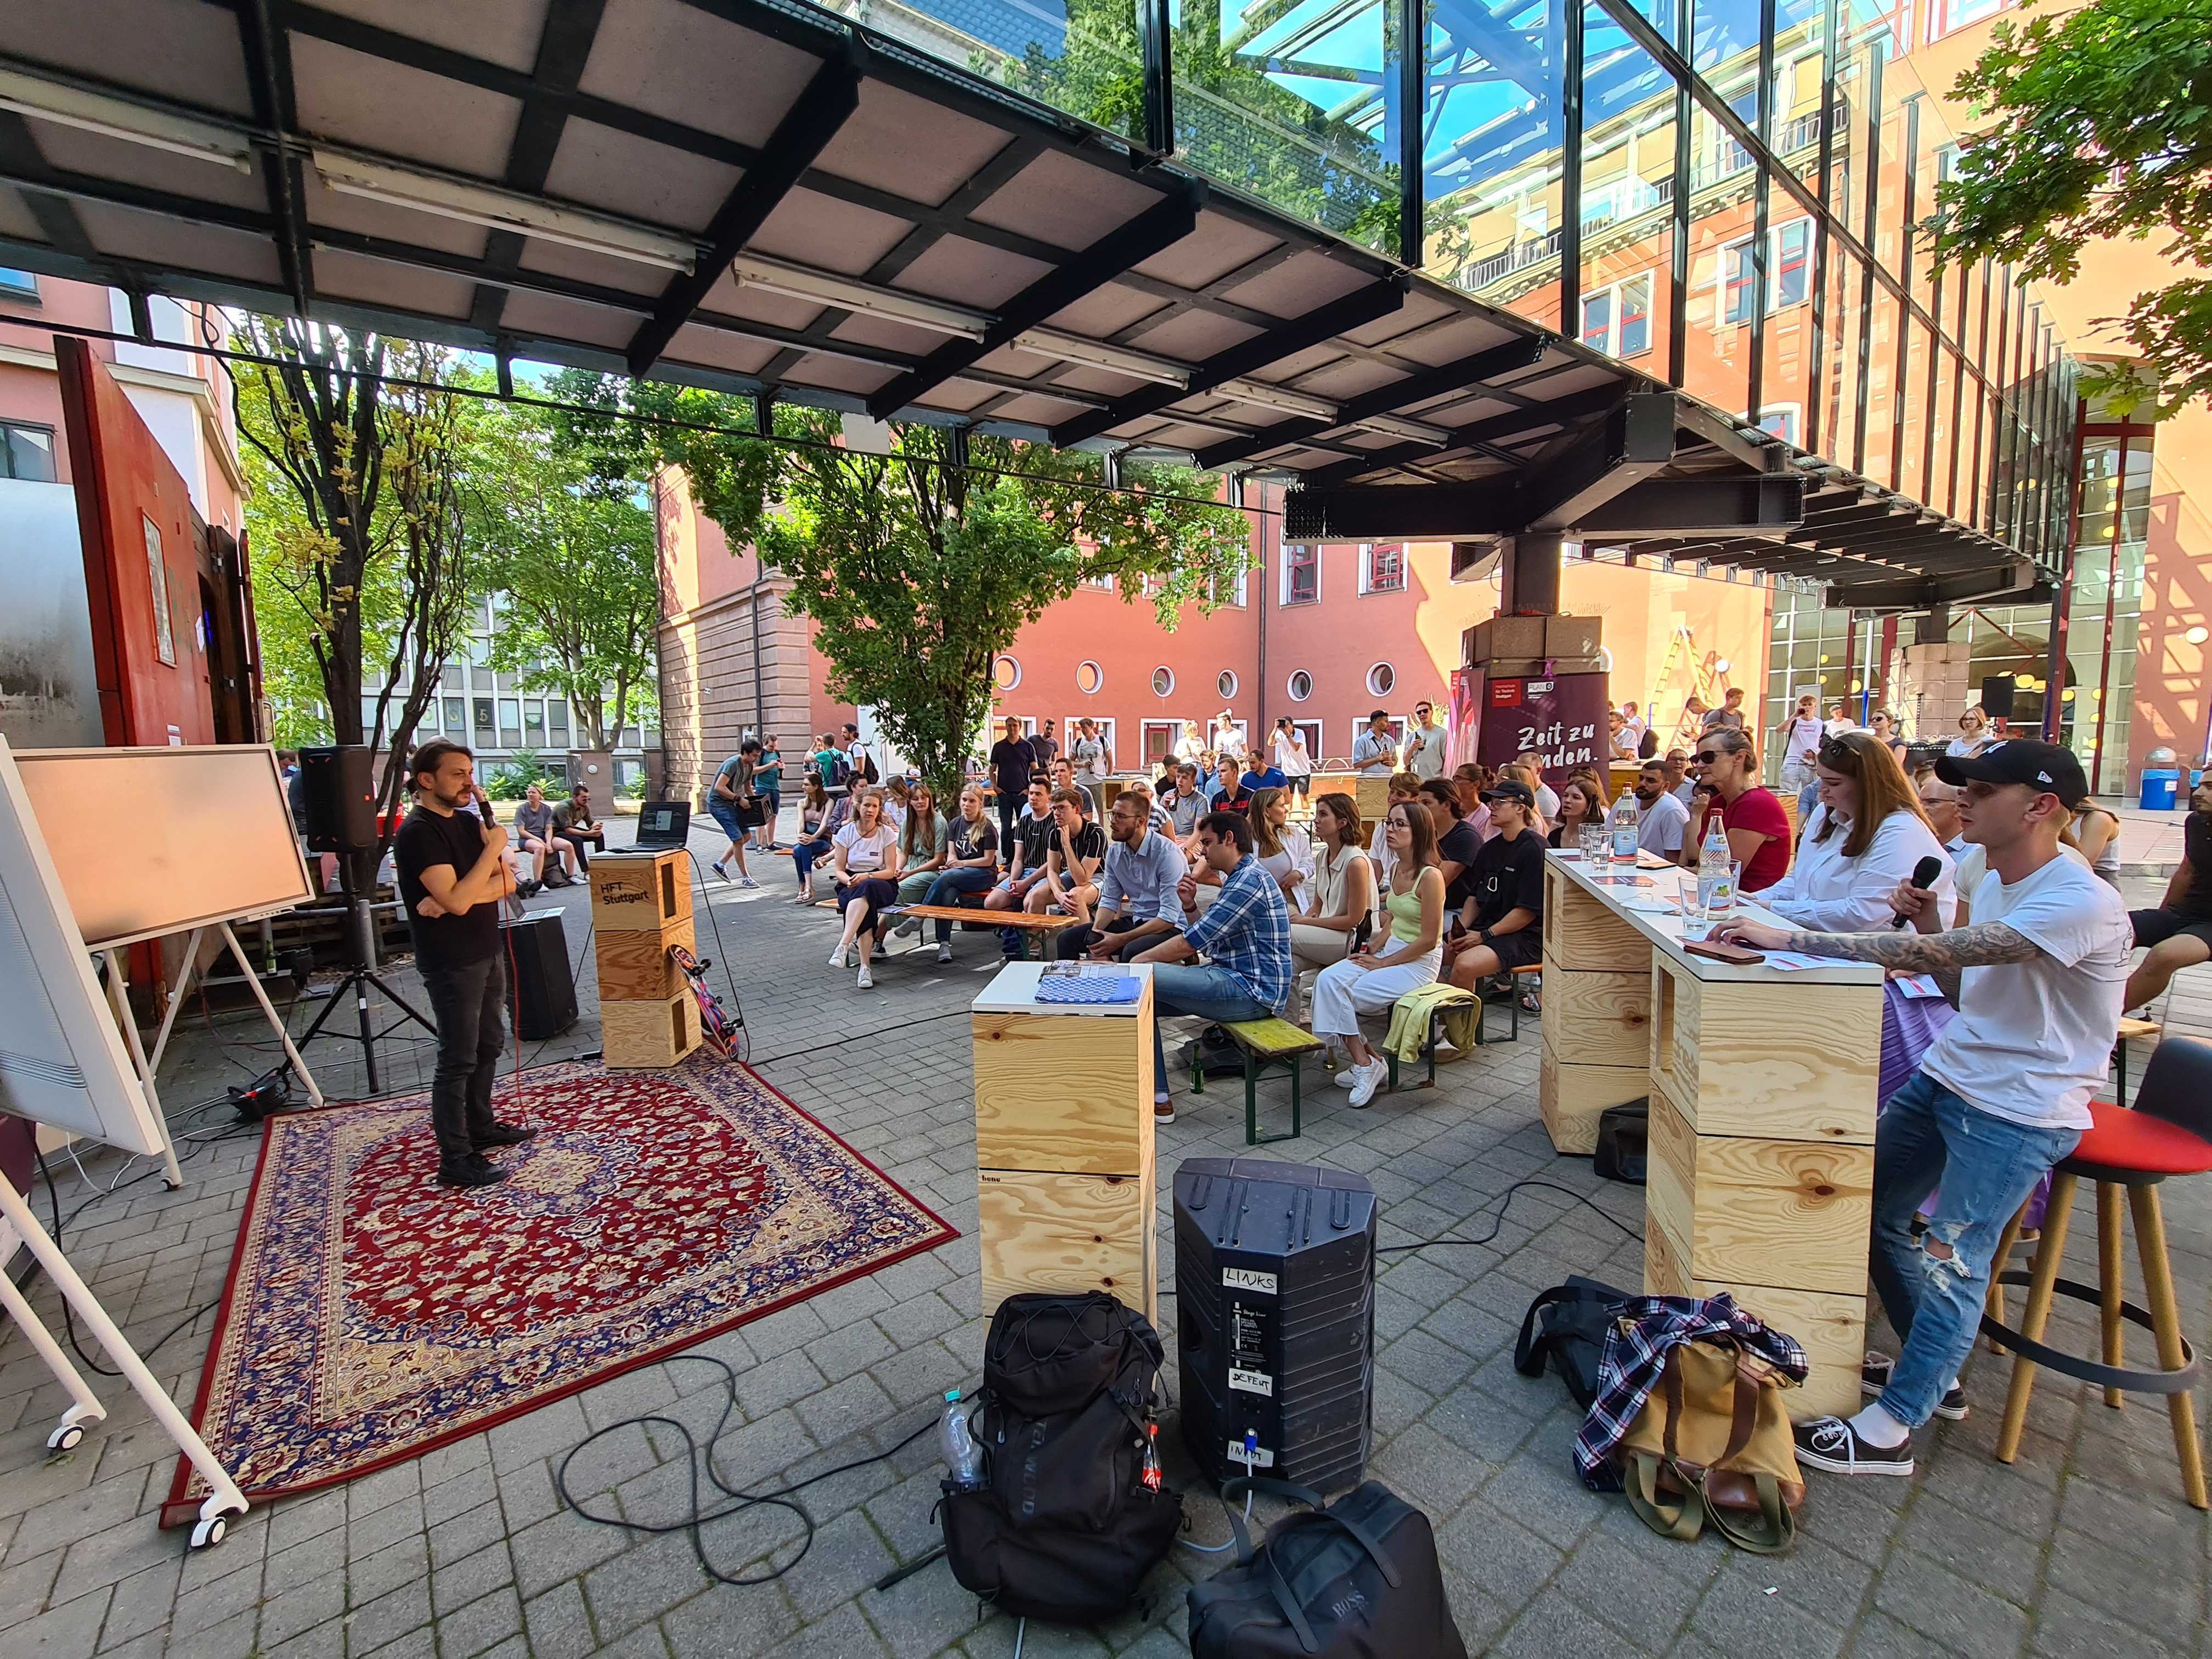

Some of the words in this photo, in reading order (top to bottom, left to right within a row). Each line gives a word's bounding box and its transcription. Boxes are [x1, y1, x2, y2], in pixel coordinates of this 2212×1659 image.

[1517, 721, 1565, 751] Zeit
[1568, 724, 1595, 742] zu
[600, 881, 624, 894] HFT
[603, 890, 650, 905] Stuttgart
[1226, 1268, 1275, 1289] LINKS
[1231, 1445, 1262, 1461] INUT
